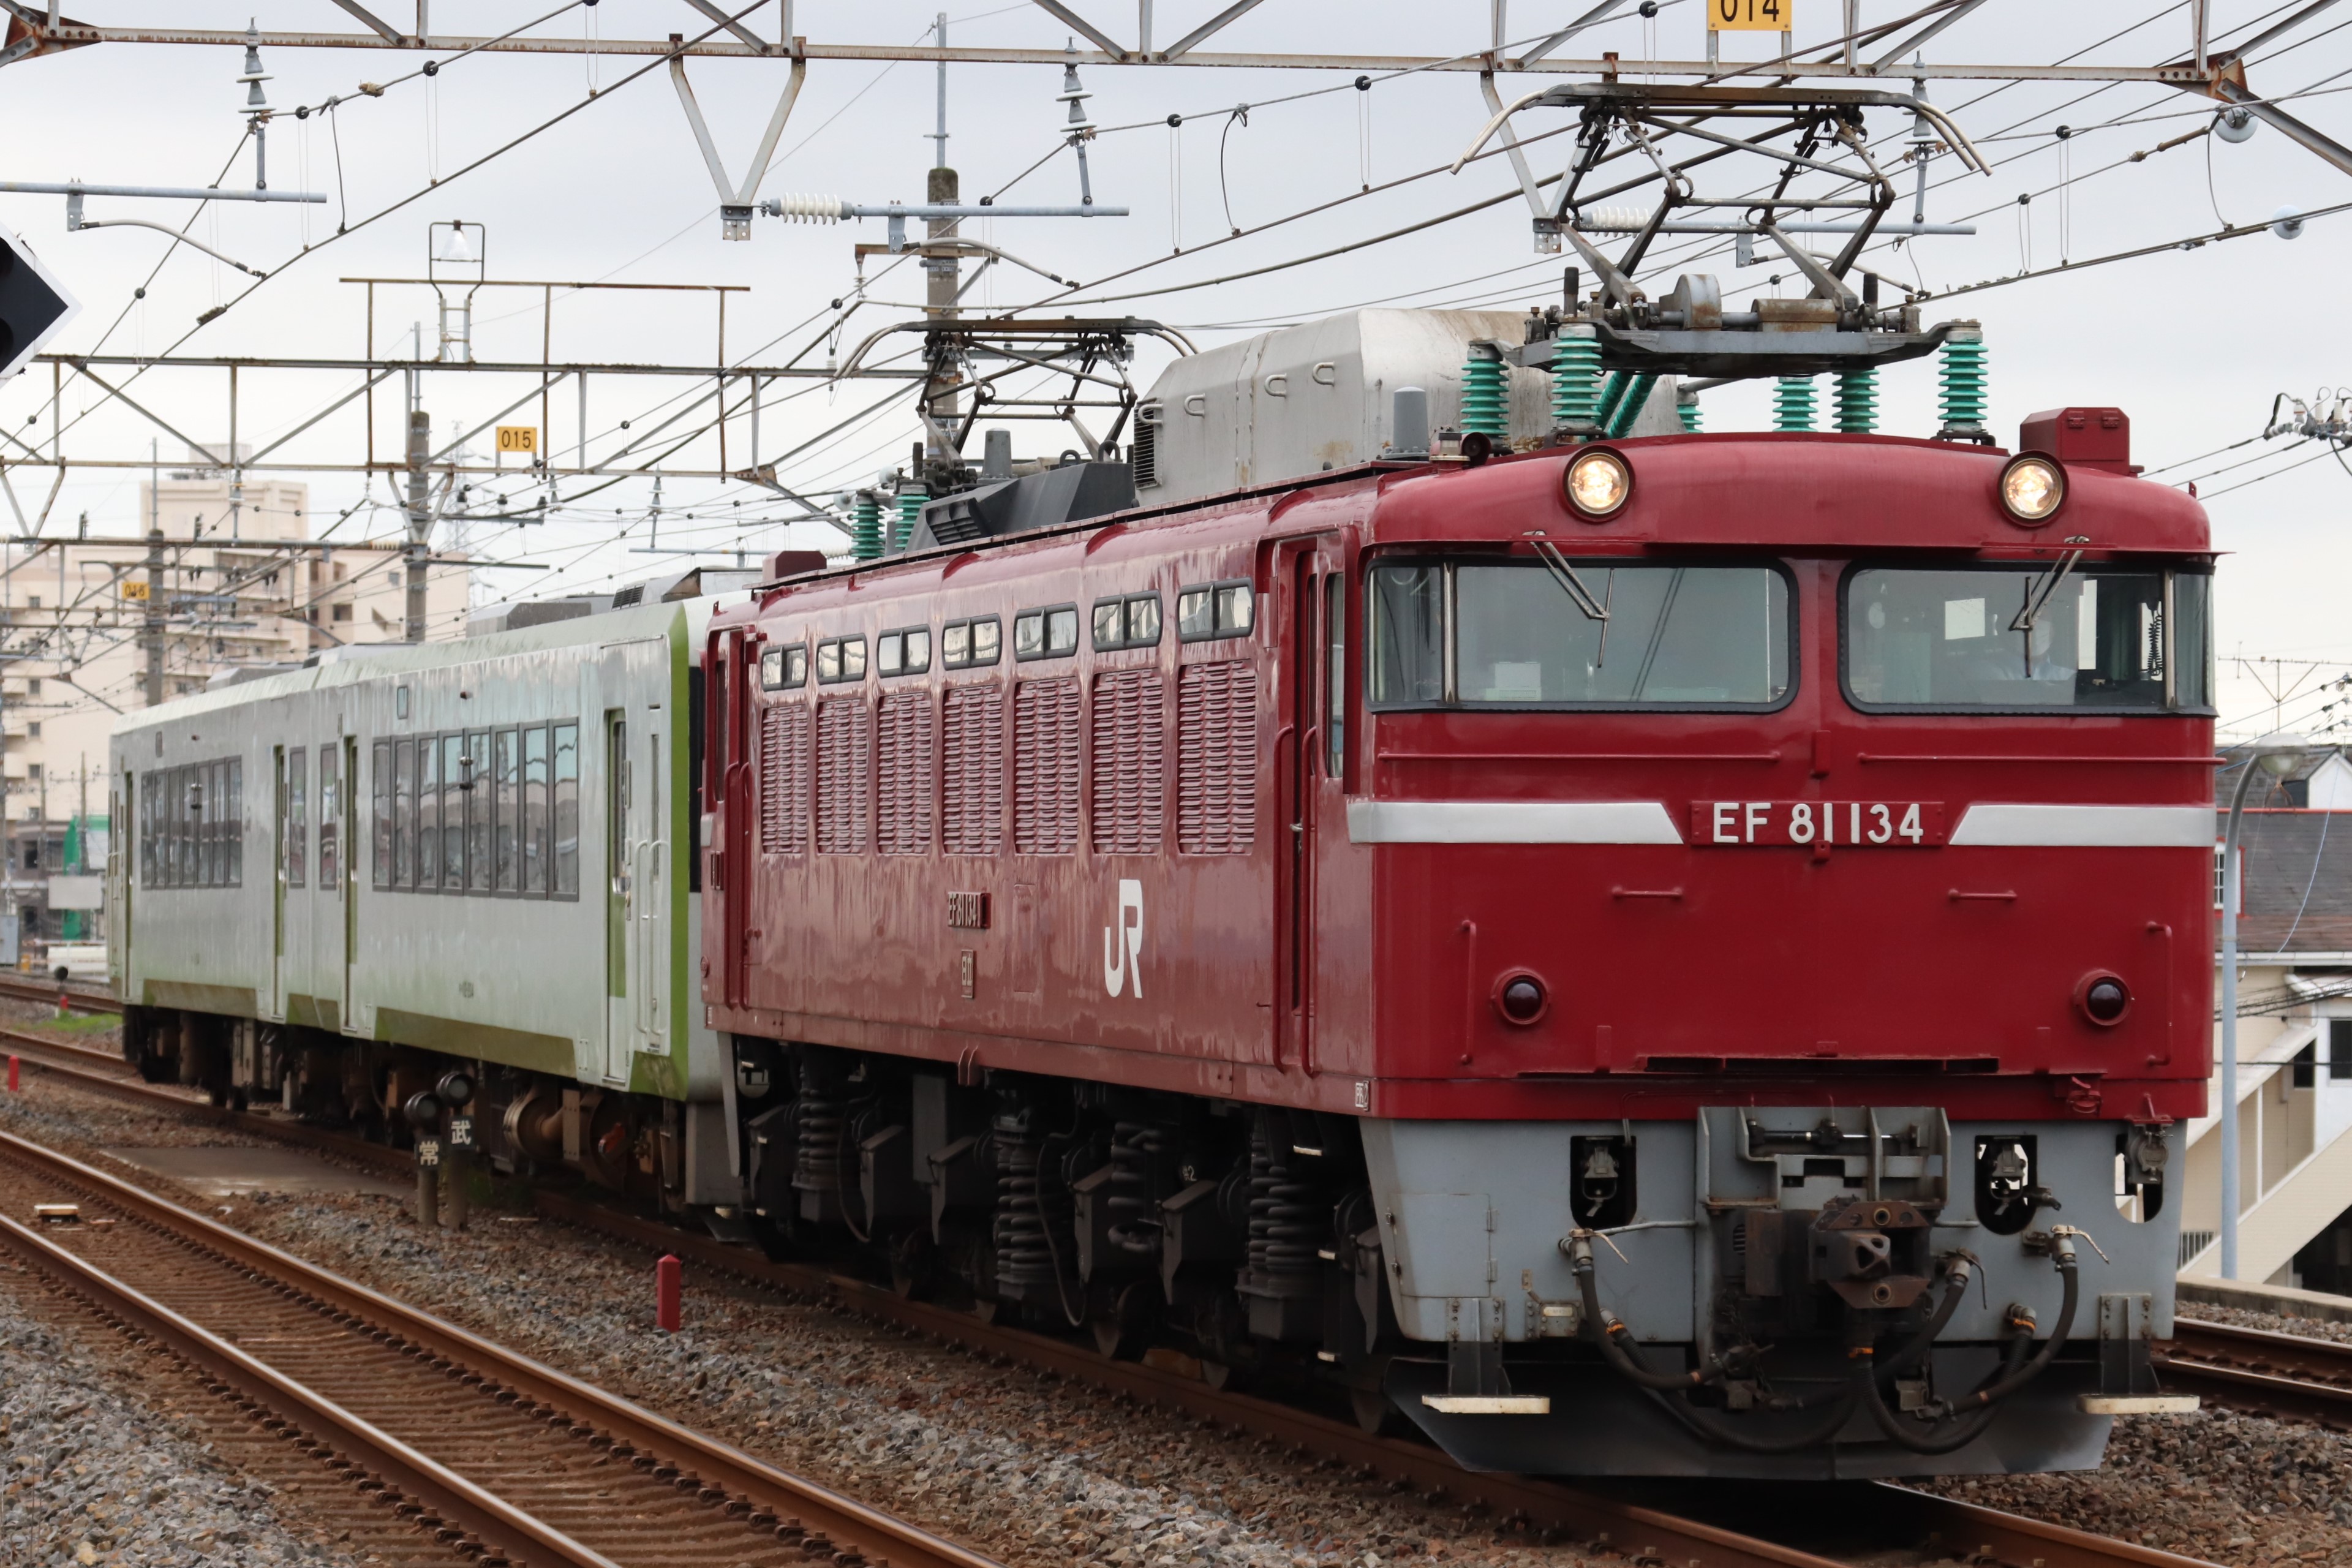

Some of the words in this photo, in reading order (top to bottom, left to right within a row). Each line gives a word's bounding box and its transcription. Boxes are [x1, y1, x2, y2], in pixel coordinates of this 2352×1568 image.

[502, 430, 531, 448] 015
[124, 584, 145, 597] 016
[1713, 802, 1771, 843] EF
[1104, 878, 1144, 998] JR
[451, 1120, 472, 1145] 武
[419, 1140, 439, 1166] 常
